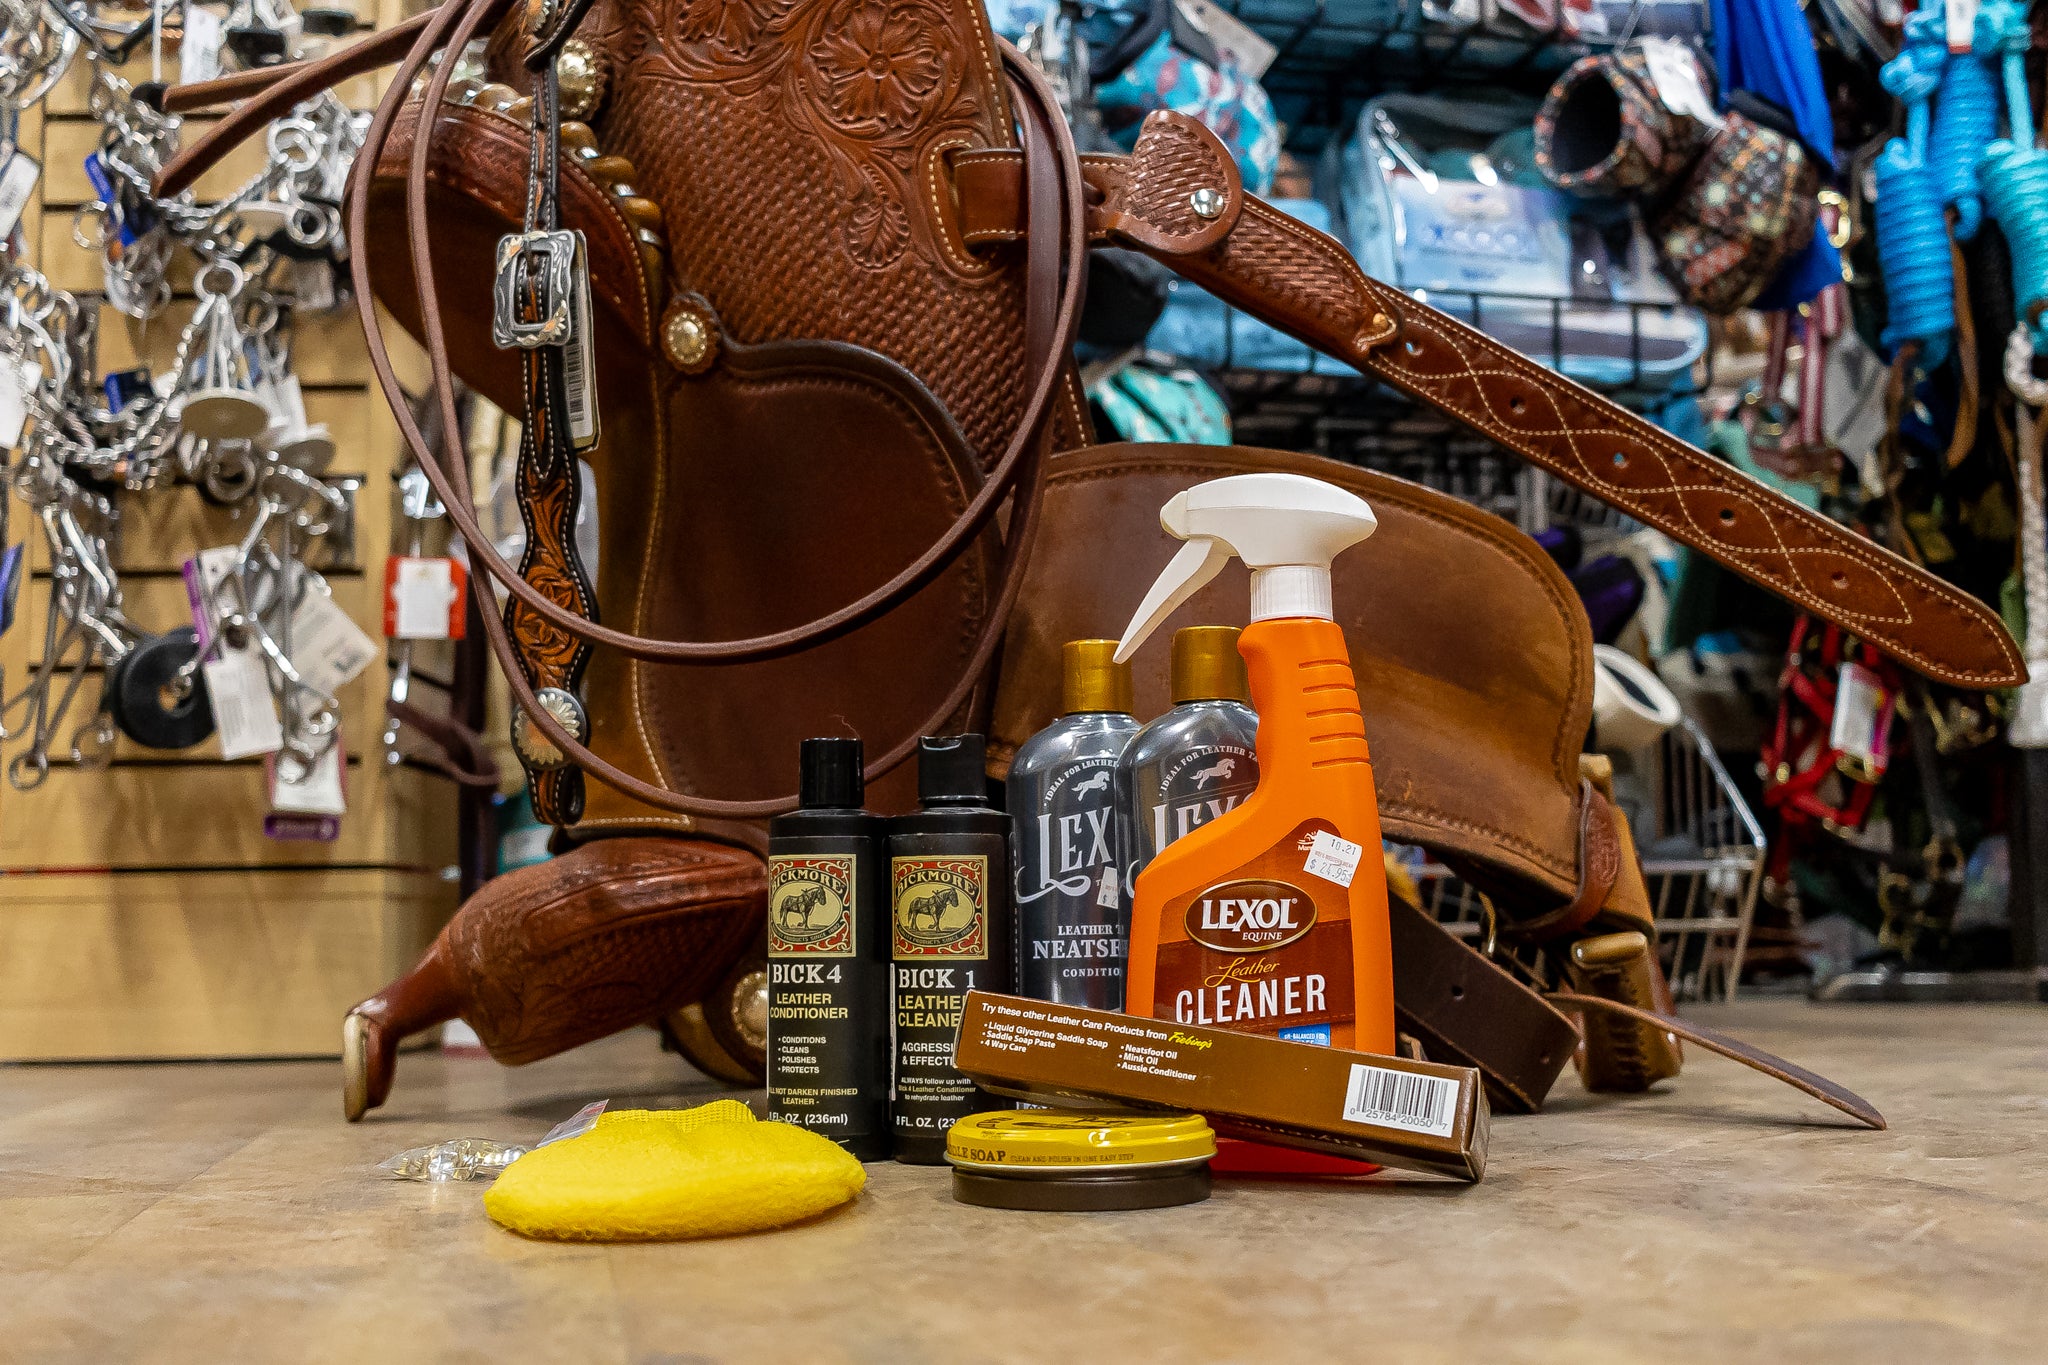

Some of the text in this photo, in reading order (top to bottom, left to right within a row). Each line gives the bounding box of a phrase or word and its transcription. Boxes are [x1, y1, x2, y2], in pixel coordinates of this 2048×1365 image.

[1160, 765, 1181, 791] IDEAL
[1181, 752, 1199, 766] FOR
[1201, 745, 1246, 756] LEATHER
[1045, 777, 1065, 801] IDEAL
[1064, 765, 1081, 779] FOR
[1331, 838, 1356, 856] 10.21
[1016, 806, 1113, 903] LEX
[897, 871, 976, 897] BICKMORE
[1058, 925, 1113, 936] LEATHER
[1242, 932, 1282, 942] EQUINE
[1032, 939, 1121, 959] NEATSF
[772, 964, 842, 984] BICK 4
[898, 968, 976, 988] BICK 1
[1062, 967, 1121, 977] CONDITIO
[1204, 957, 1280, 988] Leather
[776, 993, 832, 1005] LEATHER
[1175, 974, 1326, 1025] CLEANER
[770, 1007, 848, 1019] CONDITIONER
[898, 1012, 961, 1027] CLEANE
[982, 1002, 1213, 1050] Try these other Leather Care Products from Fiebing's
[782, 1036, 827, 1044] CONDITIONS
[986, 1030, 1056, 1049] Saddle Soap Paste
[988, 1022, 1109, 1049] Liquid Glycerine Saddle Soap
[782, 1046, 810, 1054] CLEANS
[902, 1042, 954, 1052] AGGRESSI
[984, 1039, 1027, 1053] 4 Way Care
[1125, 1044, 1178, 1060] Neatsfoot Oil
[782, 1056, 817, 1064] POLISHES
[902, 1056, 954, 1066] & EFFECTI
[1123, 1052, 1159, 1065] Mink Oil
[782, 1066, 820, 1074] PROTECTS
[1121, 1062, 1197, 1081] Aussie Conditioner
[924, 1077, 945, 1085] follow
[787, 1088, 819, 1096] DARKEN
[820, 1088, 858, 1096] FINISHED
[911, 1094, 939, 1102] rehydrate
[940, 1094, 965, 1102] leather
[782, 1097, 815, 1105] LEATHER
[785, 1113, 802, 1124] OZ.
[804, 1113, 848, 1126] (236ml)
[901, 1116, 914, 1127] FL.
[915, 1117, 935, 1128] OZ.
[1349, 1107, 1356, 1115] 0
[1366, 1109, 1397, 1122] 25784
[1400, 1115, 1433, 1128] 20050
[970, 1148, 1006, 1162] SOAP
[1099, 1154, 1117, 1162] EASY
